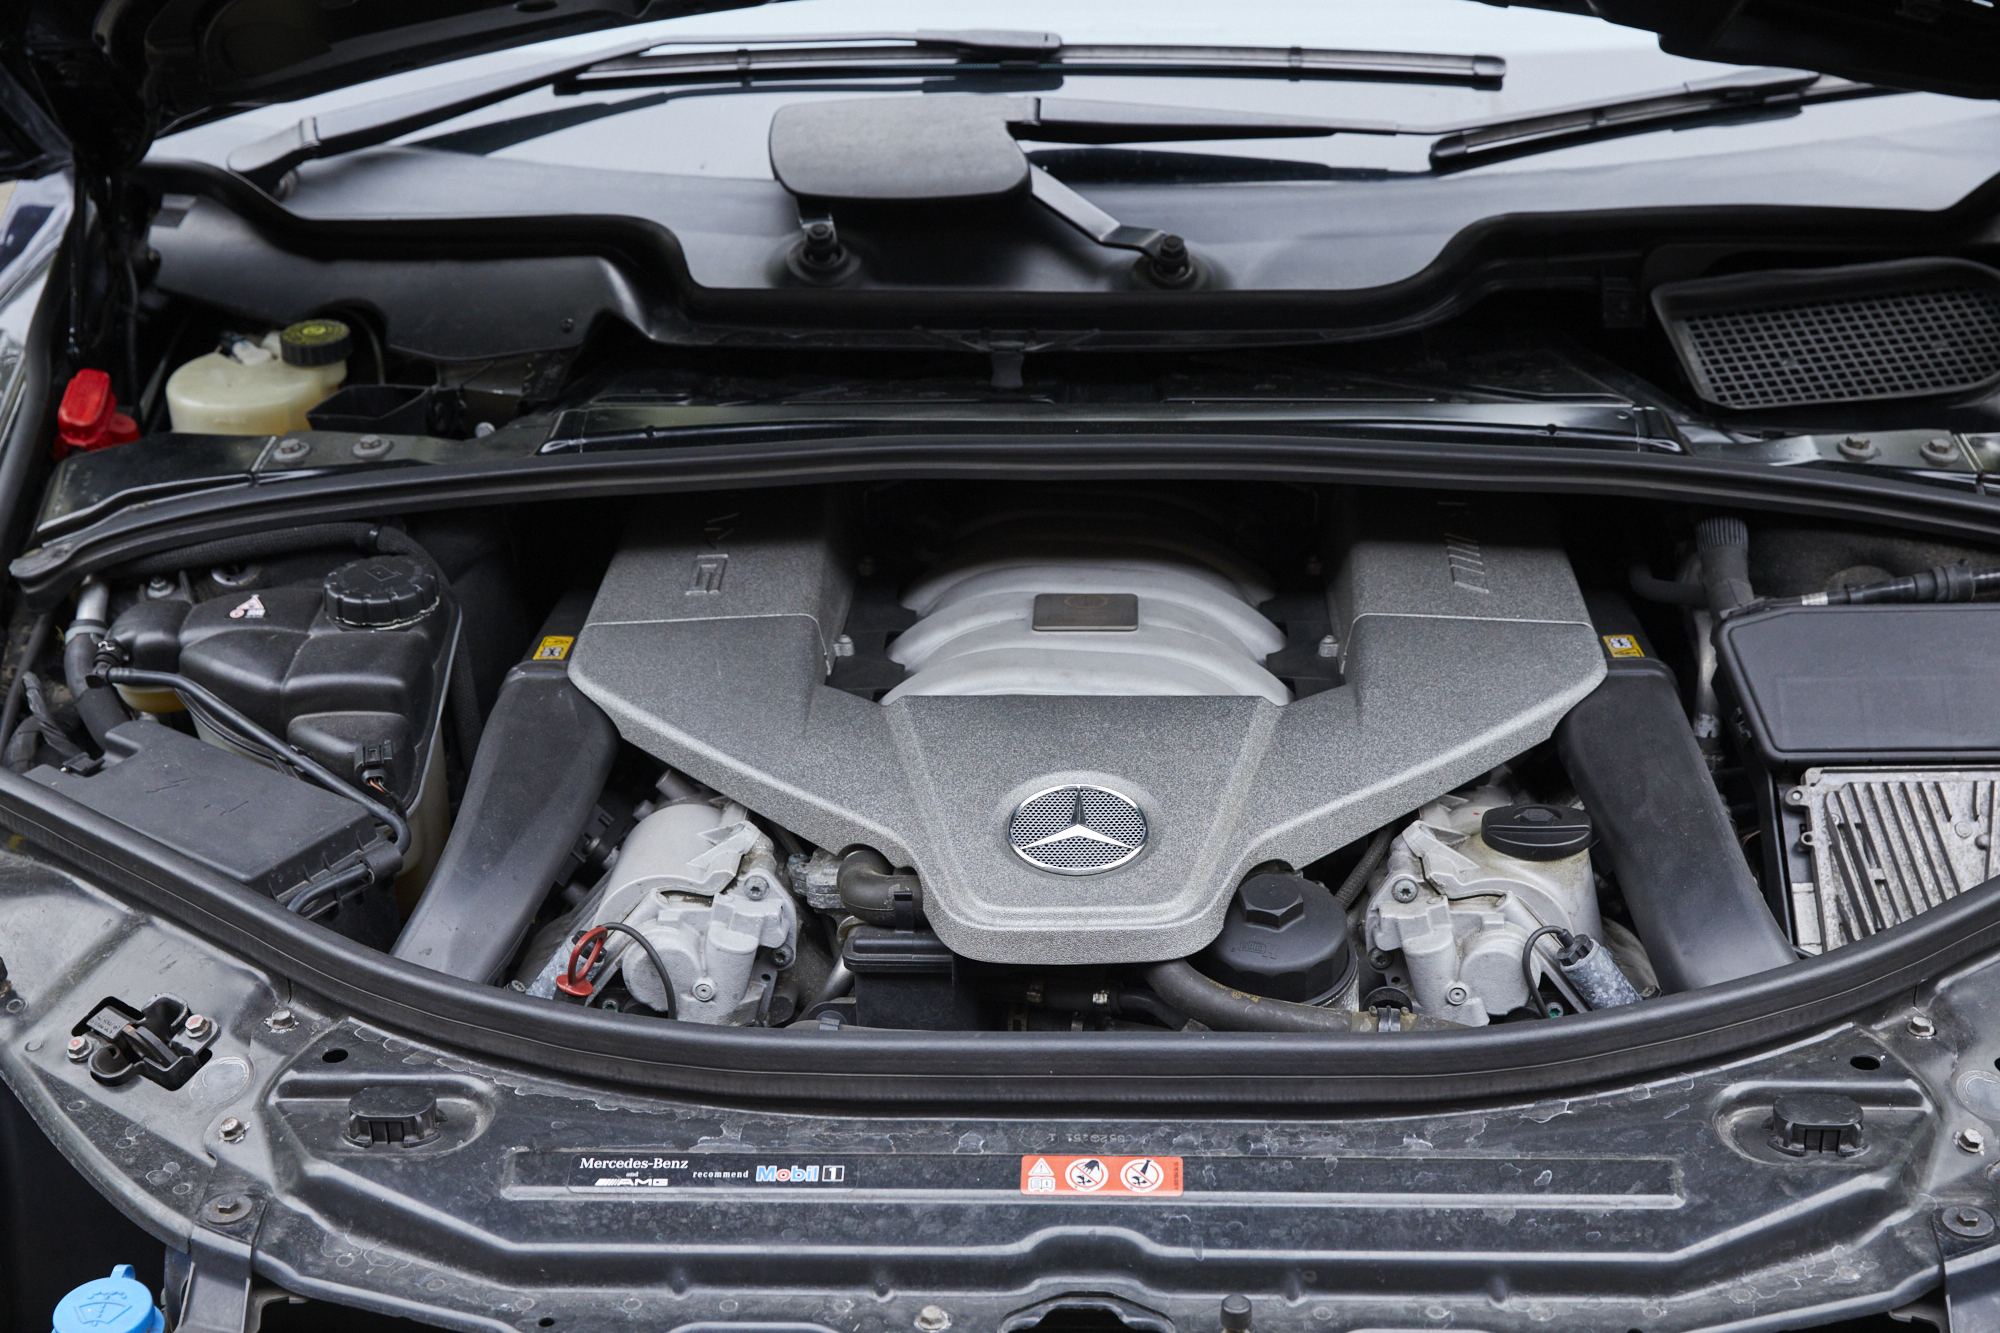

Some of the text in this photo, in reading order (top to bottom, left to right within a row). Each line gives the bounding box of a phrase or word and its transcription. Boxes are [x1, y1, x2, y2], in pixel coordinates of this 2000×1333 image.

[580, 1157, 689, 1169] Mercedes-Benz
[692, 1170, 749, 1178] recommend
[756, 1165, 820, 1182] Mobil
[616, 1178, 669, 1187] AMG
